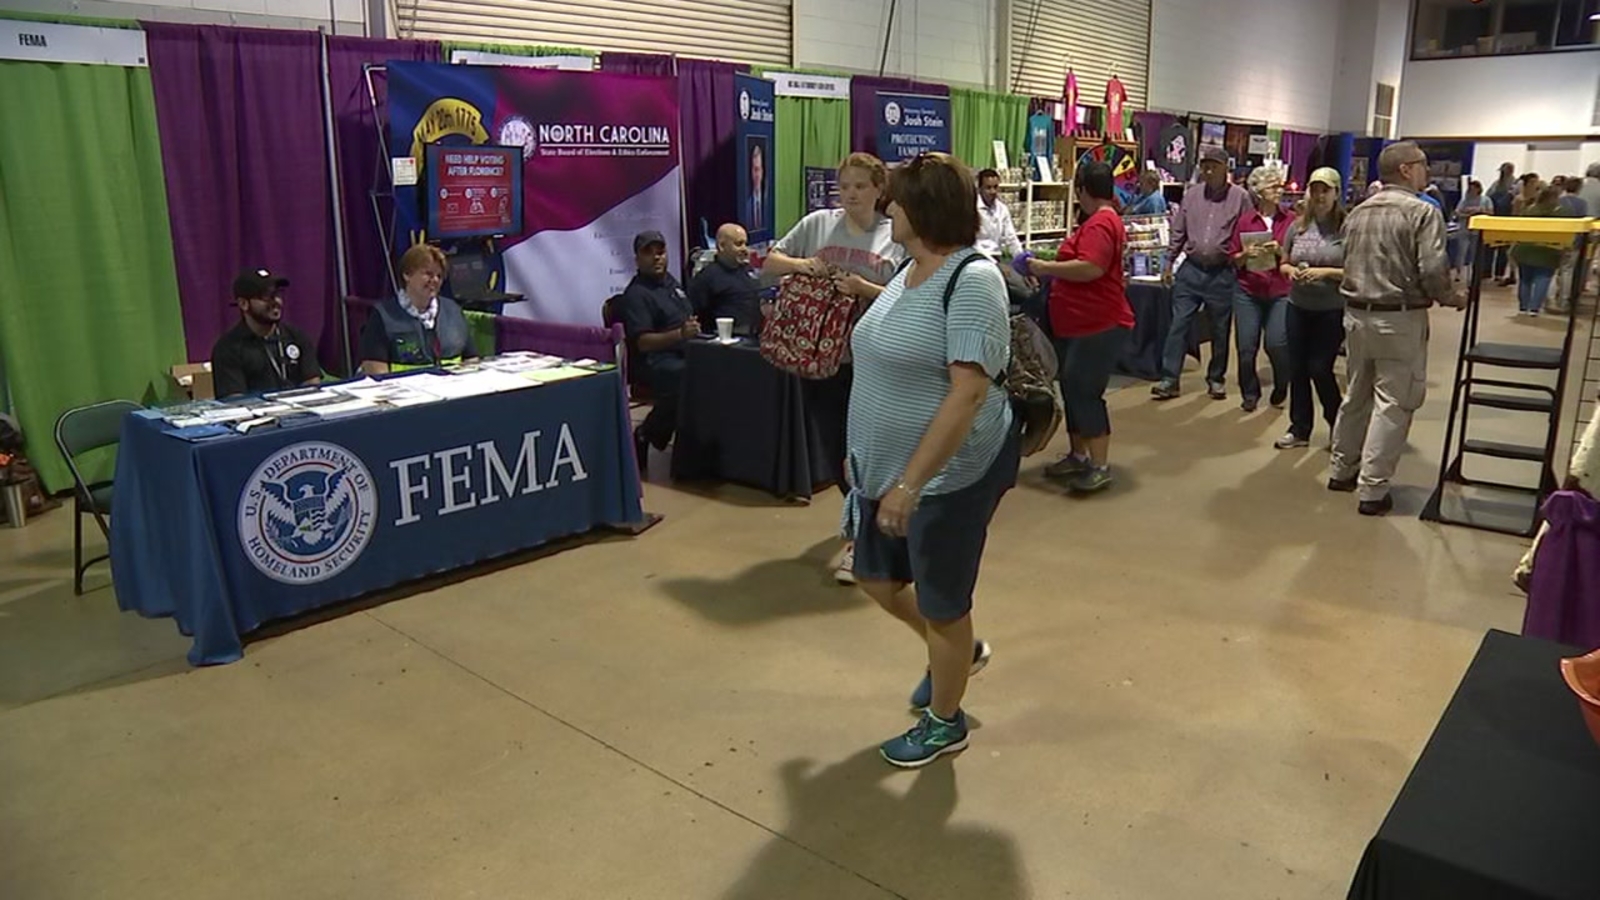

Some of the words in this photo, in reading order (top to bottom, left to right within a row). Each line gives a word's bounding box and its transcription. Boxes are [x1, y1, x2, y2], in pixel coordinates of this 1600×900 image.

[18, 33, 47, 47] FEMA
[904, 114, 922, 126] Josh
[924, 115, 944, 127] Stein
[539, 124, 595, 143] NORTH
[599, 125, 670, 144] CAROLINA
[891, 133, 937, 146] PROTECTING
[445, 154, 462, 164] NEED
[463, 154, 479, 164] HELP
[480, 154, 504, 164] VOTING
[448, 166, 468, 176] AFTER
[263, 447, 358, 480] DEPARTMENT
[354, 472, 371, 493] OF
[389, 422, 588, 527] FEMA
[248, 536, 321, 578] HOMELAND
[324, 510, 371, 571] SECURITY
